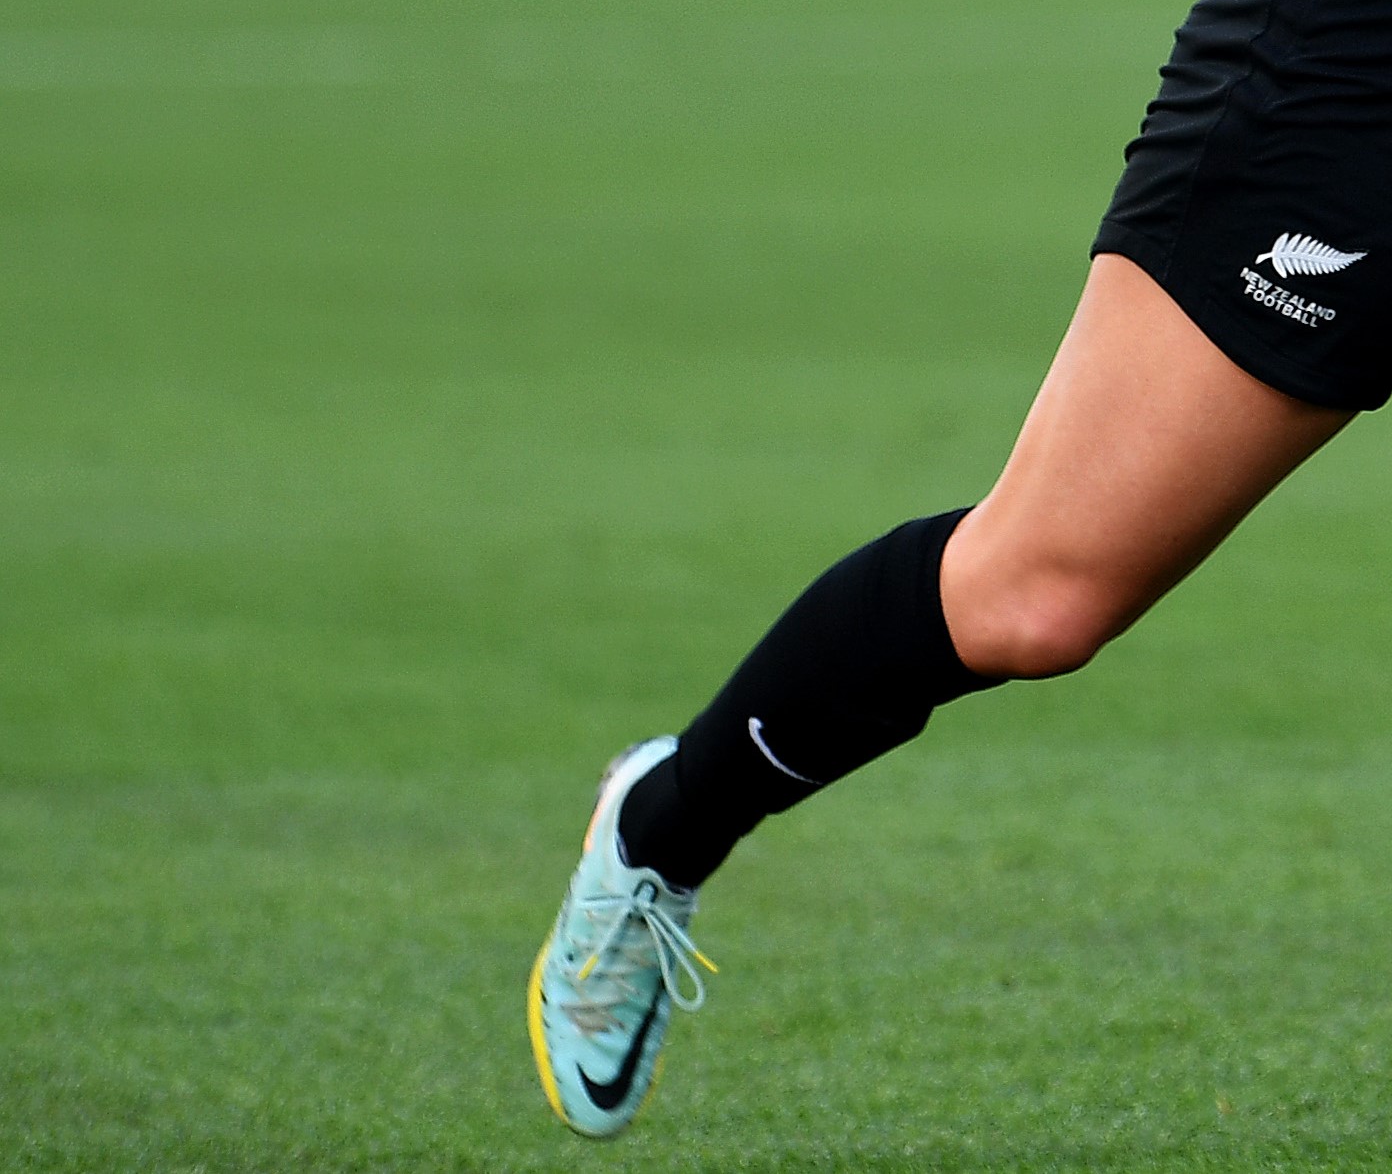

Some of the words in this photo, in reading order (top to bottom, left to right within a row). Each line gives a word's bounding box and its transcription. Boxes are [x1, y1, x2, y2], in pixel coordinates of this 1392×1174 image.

[1240, 267, 1273, 291] NEW
[1271, 285, 1337, 321] ZEALAND
[1244, 284, 1318, 327] FOOTBALL
